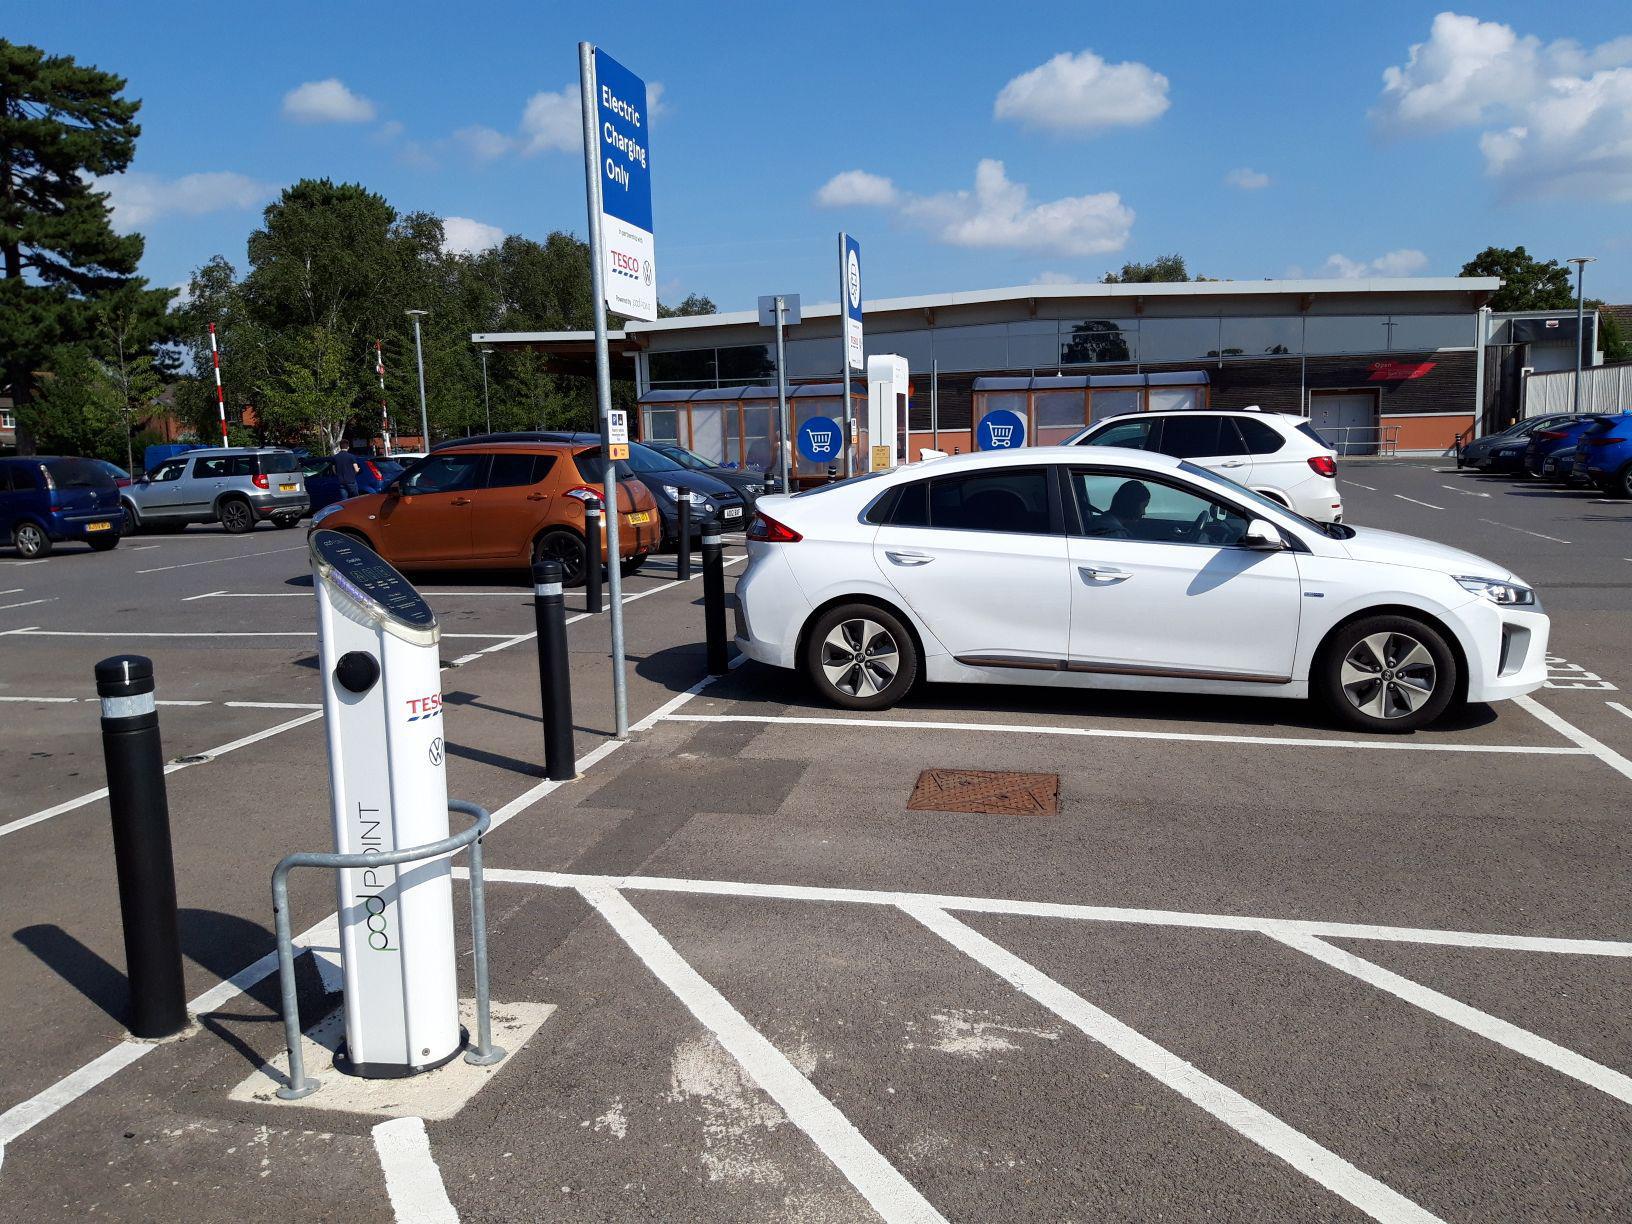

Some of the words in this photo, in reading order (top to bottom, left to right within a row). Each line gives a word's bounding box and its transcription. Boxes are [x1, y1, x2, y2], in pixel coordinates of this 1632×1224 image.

[602, 85, 641, 128] Electric
[604, 121, 647, 169] Charging
[606, 157, 630, 192] Only
[610, 249, 639, 273] TESCO
